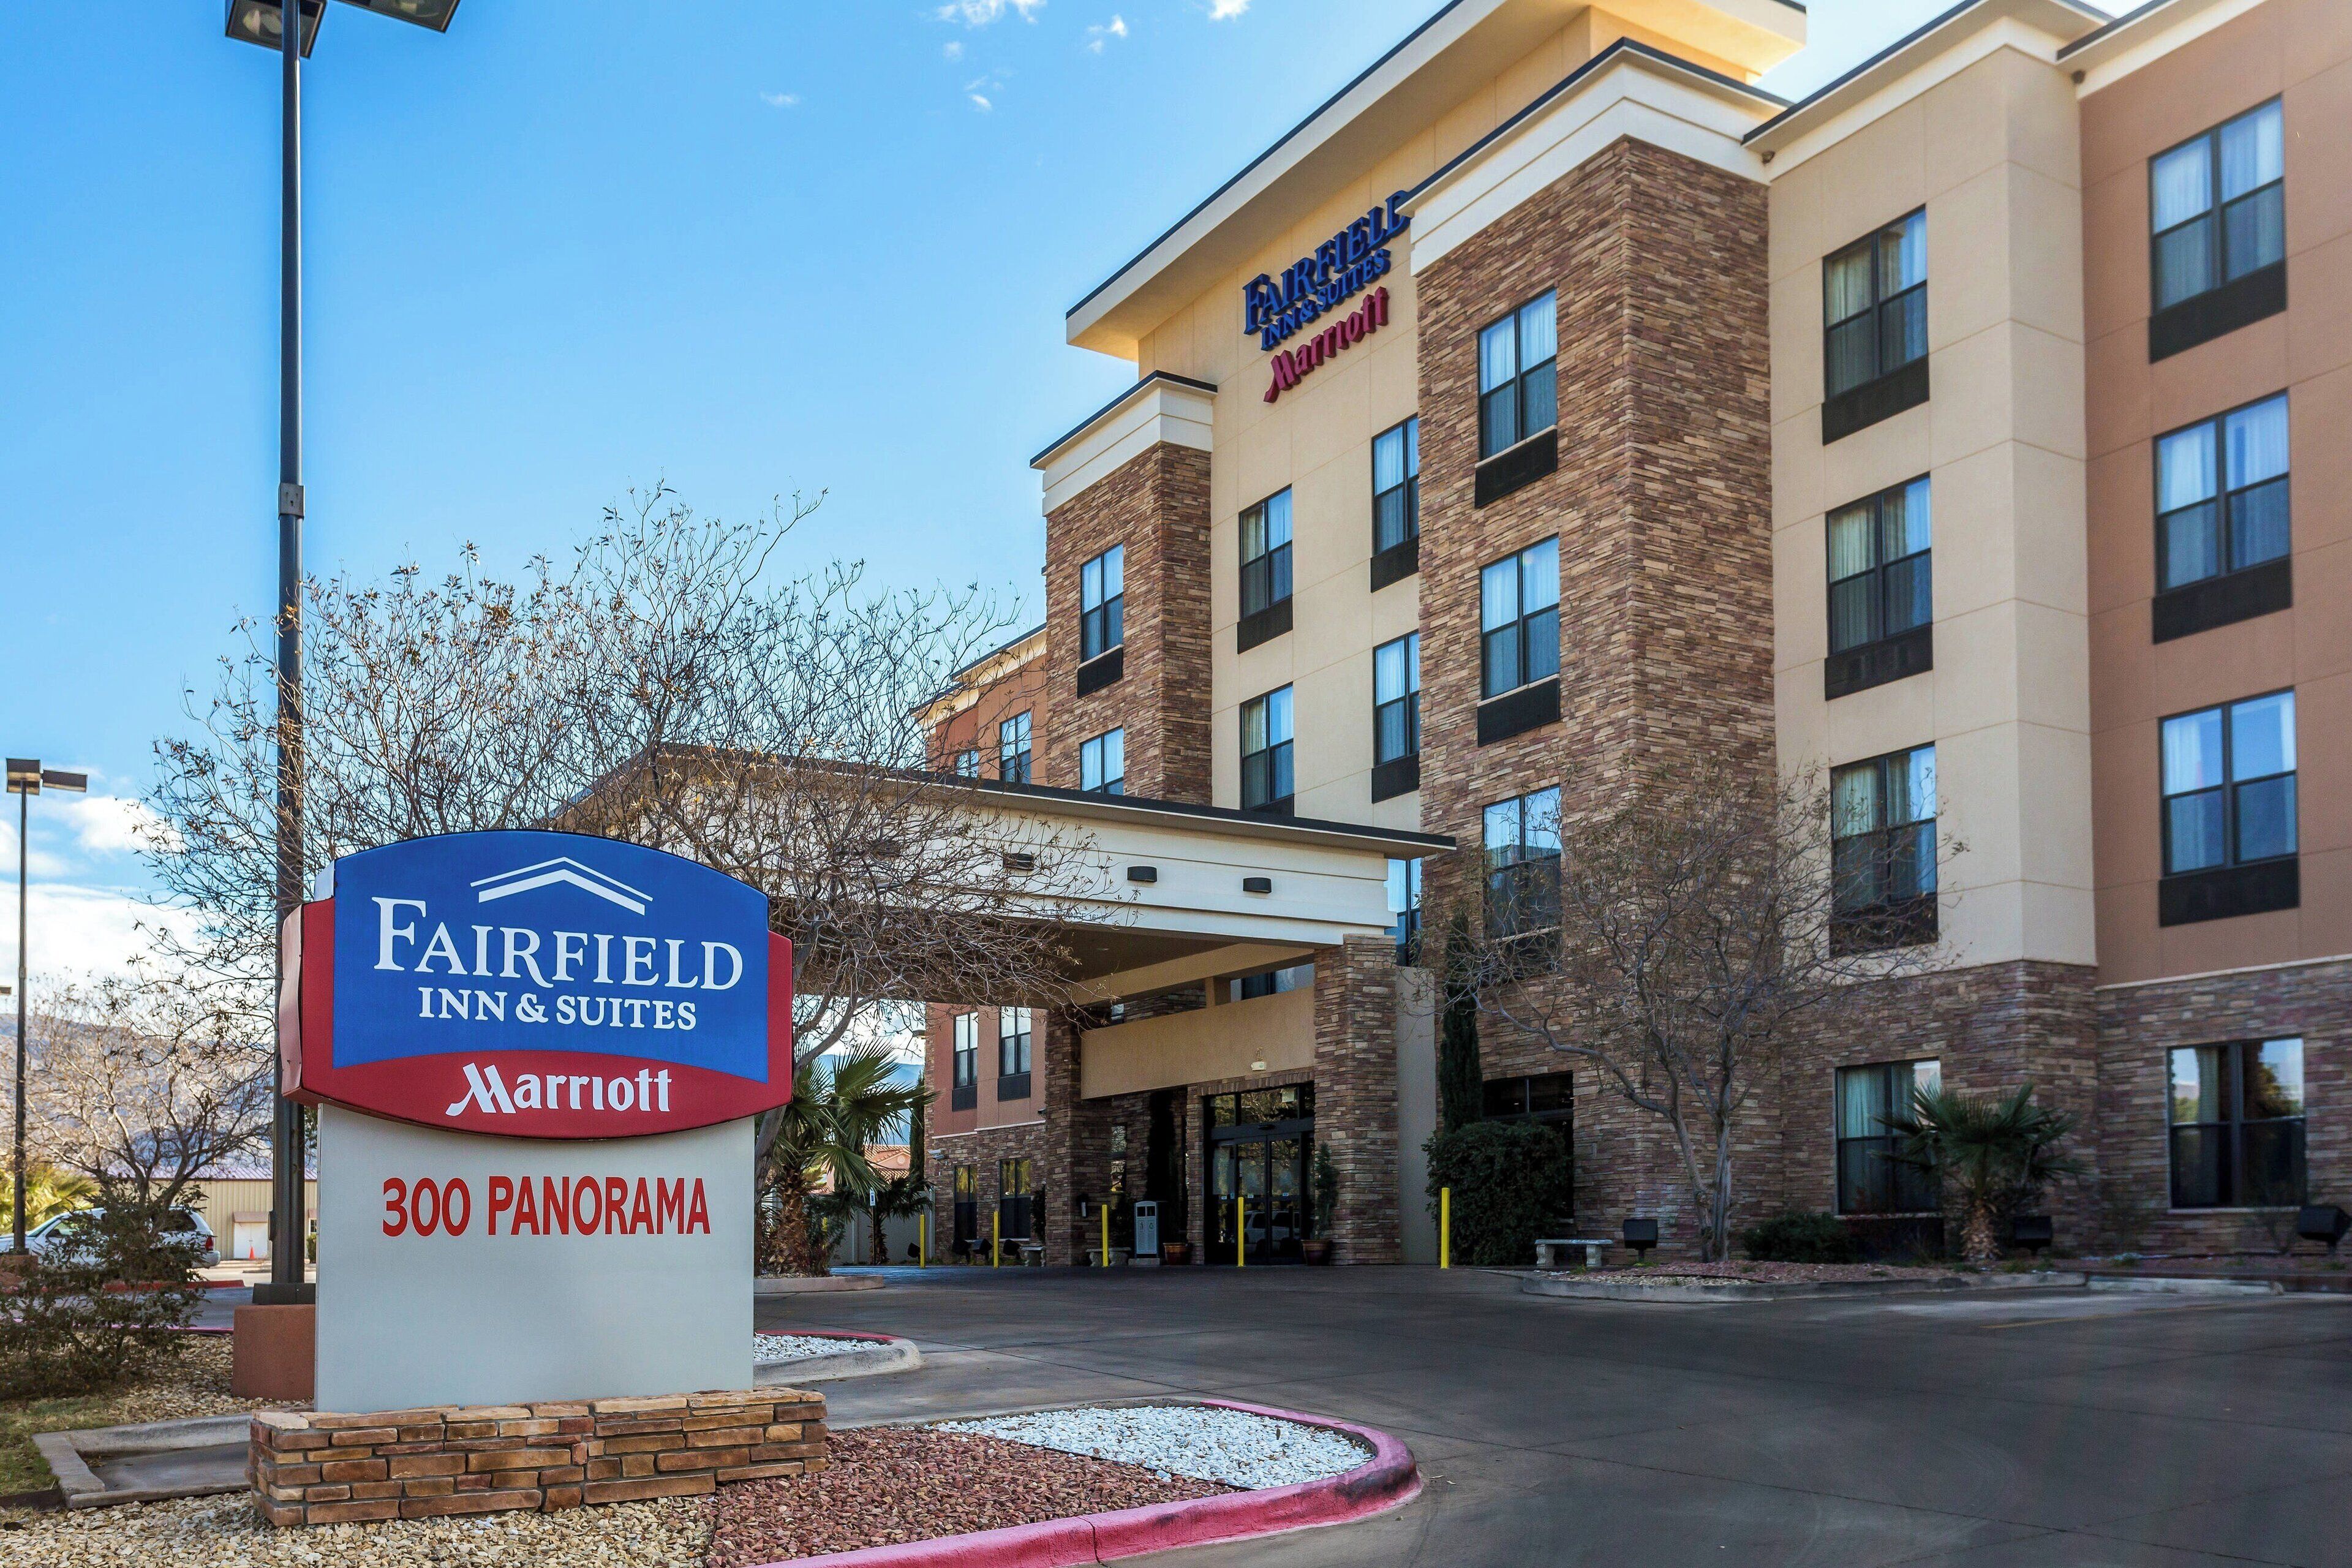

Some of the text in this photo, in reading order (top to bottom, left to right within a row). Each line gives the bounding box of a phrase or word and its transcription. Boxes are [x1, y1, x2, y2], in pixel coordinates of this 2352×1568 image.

[1243, 190, 1411, 335] FAIRFIELD
[1261, 306, 1302, 351] INN
[1317, 247, 1391, 313] SUITES
[1263, 286, 1389, 403] Marriott
[371, 896, 743, 990] FAIRFIELD
[418, 987, 696, 1031] INN & SUITES
[445, 1062, 673, 1117] Marriott
[383, 1176, 710, 1237] 300 PANORAMA
